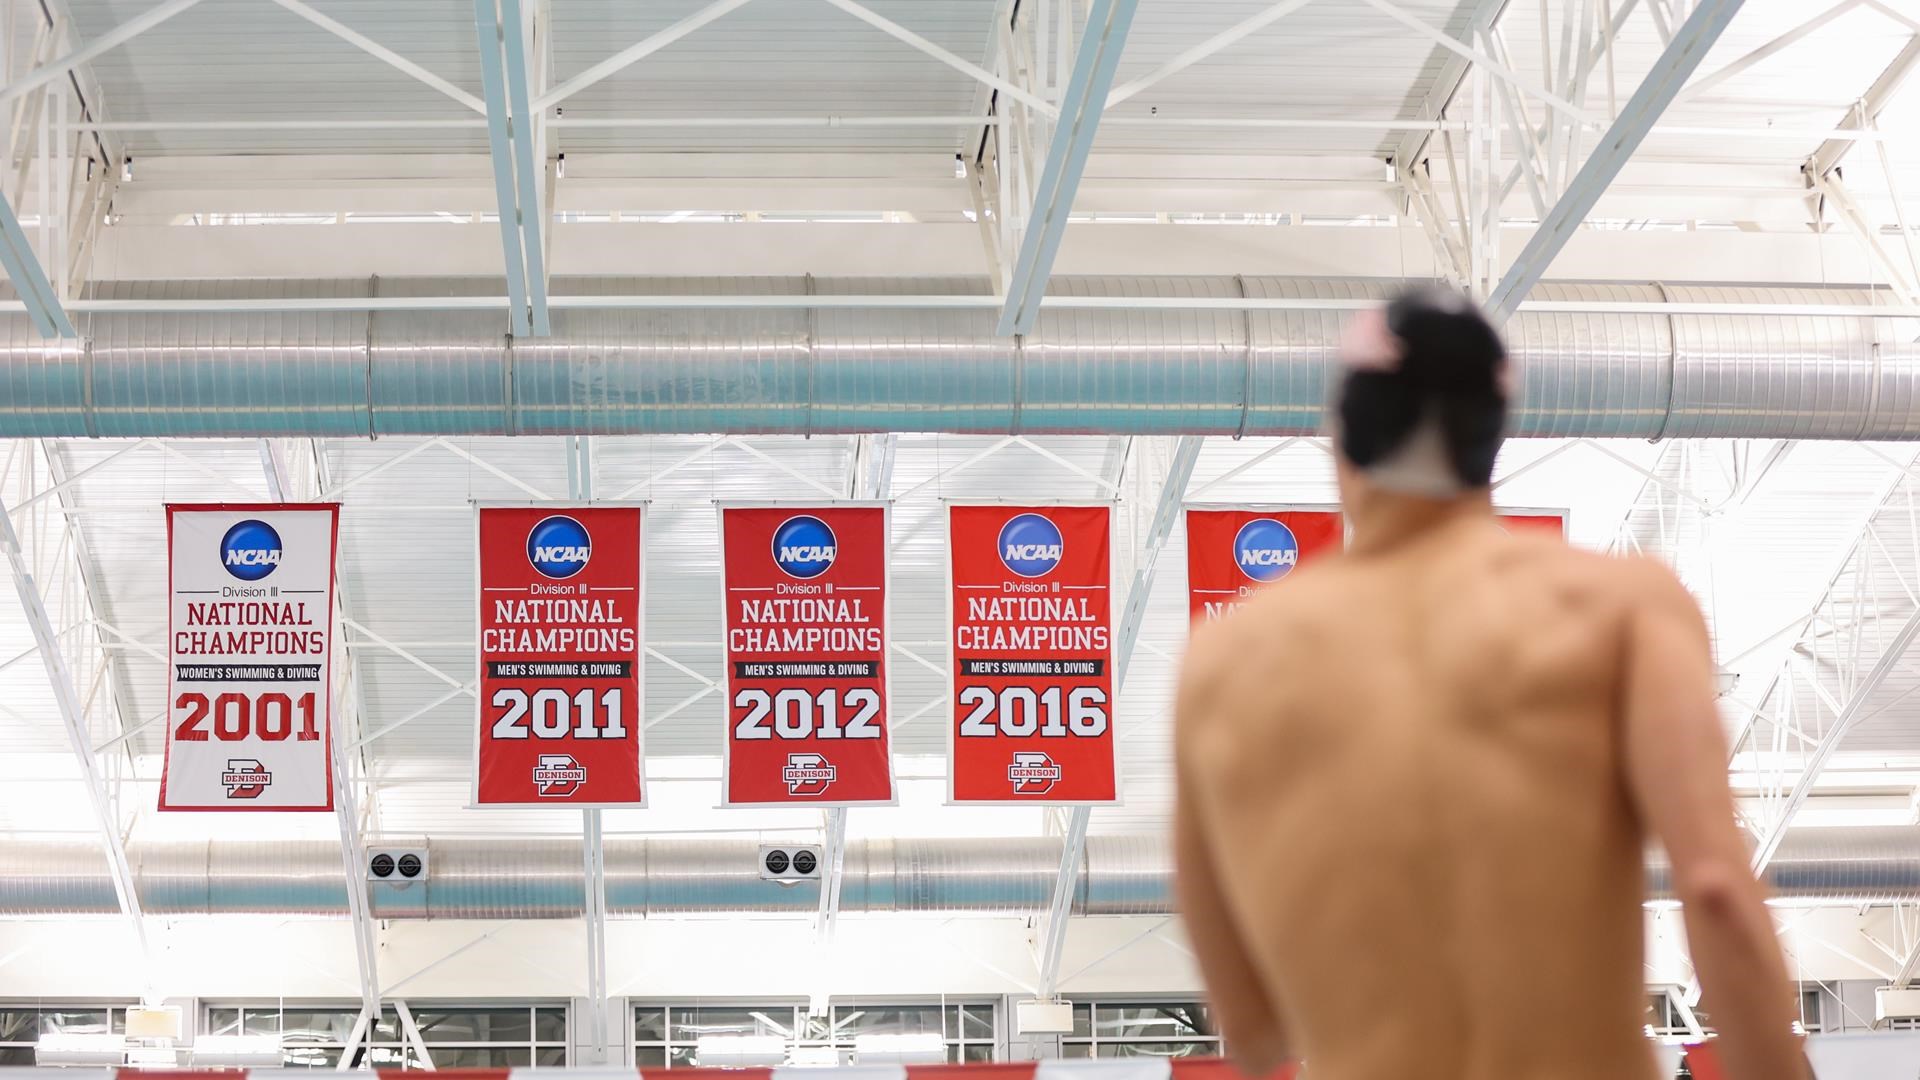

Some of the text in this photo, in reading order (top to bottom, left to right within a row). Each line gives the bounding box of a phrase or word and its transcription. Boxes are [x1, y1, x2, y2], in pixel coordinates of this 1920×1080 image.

[226, 549, 282, 566] NCAA
[534, 547, 589, 562] NCAA
[780, 546, 835, 562] NCAA
[1005, 545, 1060, 561] NCAA
[1241, 549, 1296, 565] NCAA
[222, 586, 266, 598] Division
[531, 584, 575, 595] Division
[777, 583, 821, 595] Division
[1004, 582, 1048, 593] Division
[188, 603, 312, 625] NATIONAL
[495, 600, 622, 623] NATIONAL
[741, 600, 869, 623] NATIONAL
[968, 598, 1095, 621] NATIONAL
[176, 632, 323, 654] CHAMPIONS
[483, 628, 634, 652] CHAMPIONS
[730, 628, 881, 652] CHAMPIONS
[957, 626, 1108, 650] CHAMPIONS
[180, 666, 317, 679] WOMEN'S SWIMMING & DIVING
[498, 664, 621, 675] MEN'S SWIMMING & DIVING
[745, 664, 868, 676] MEN'S SWIMMING & DIVING
[971, 662, 1094, 673] MEN'S SWIMMING & DIVING
[175, 693, 319, 741] 2001
[491, 688, 627, 739] 2011
[734, 688, 881, 740] 2012
[959, 686, 1107, 737] 2016
[225, 774, 268, 782] DENISON
[538, 771, 581, 779] DENISON
[788, 770, 831, 778] DENISON
[1013, 768, 1056, 777] DENISON
